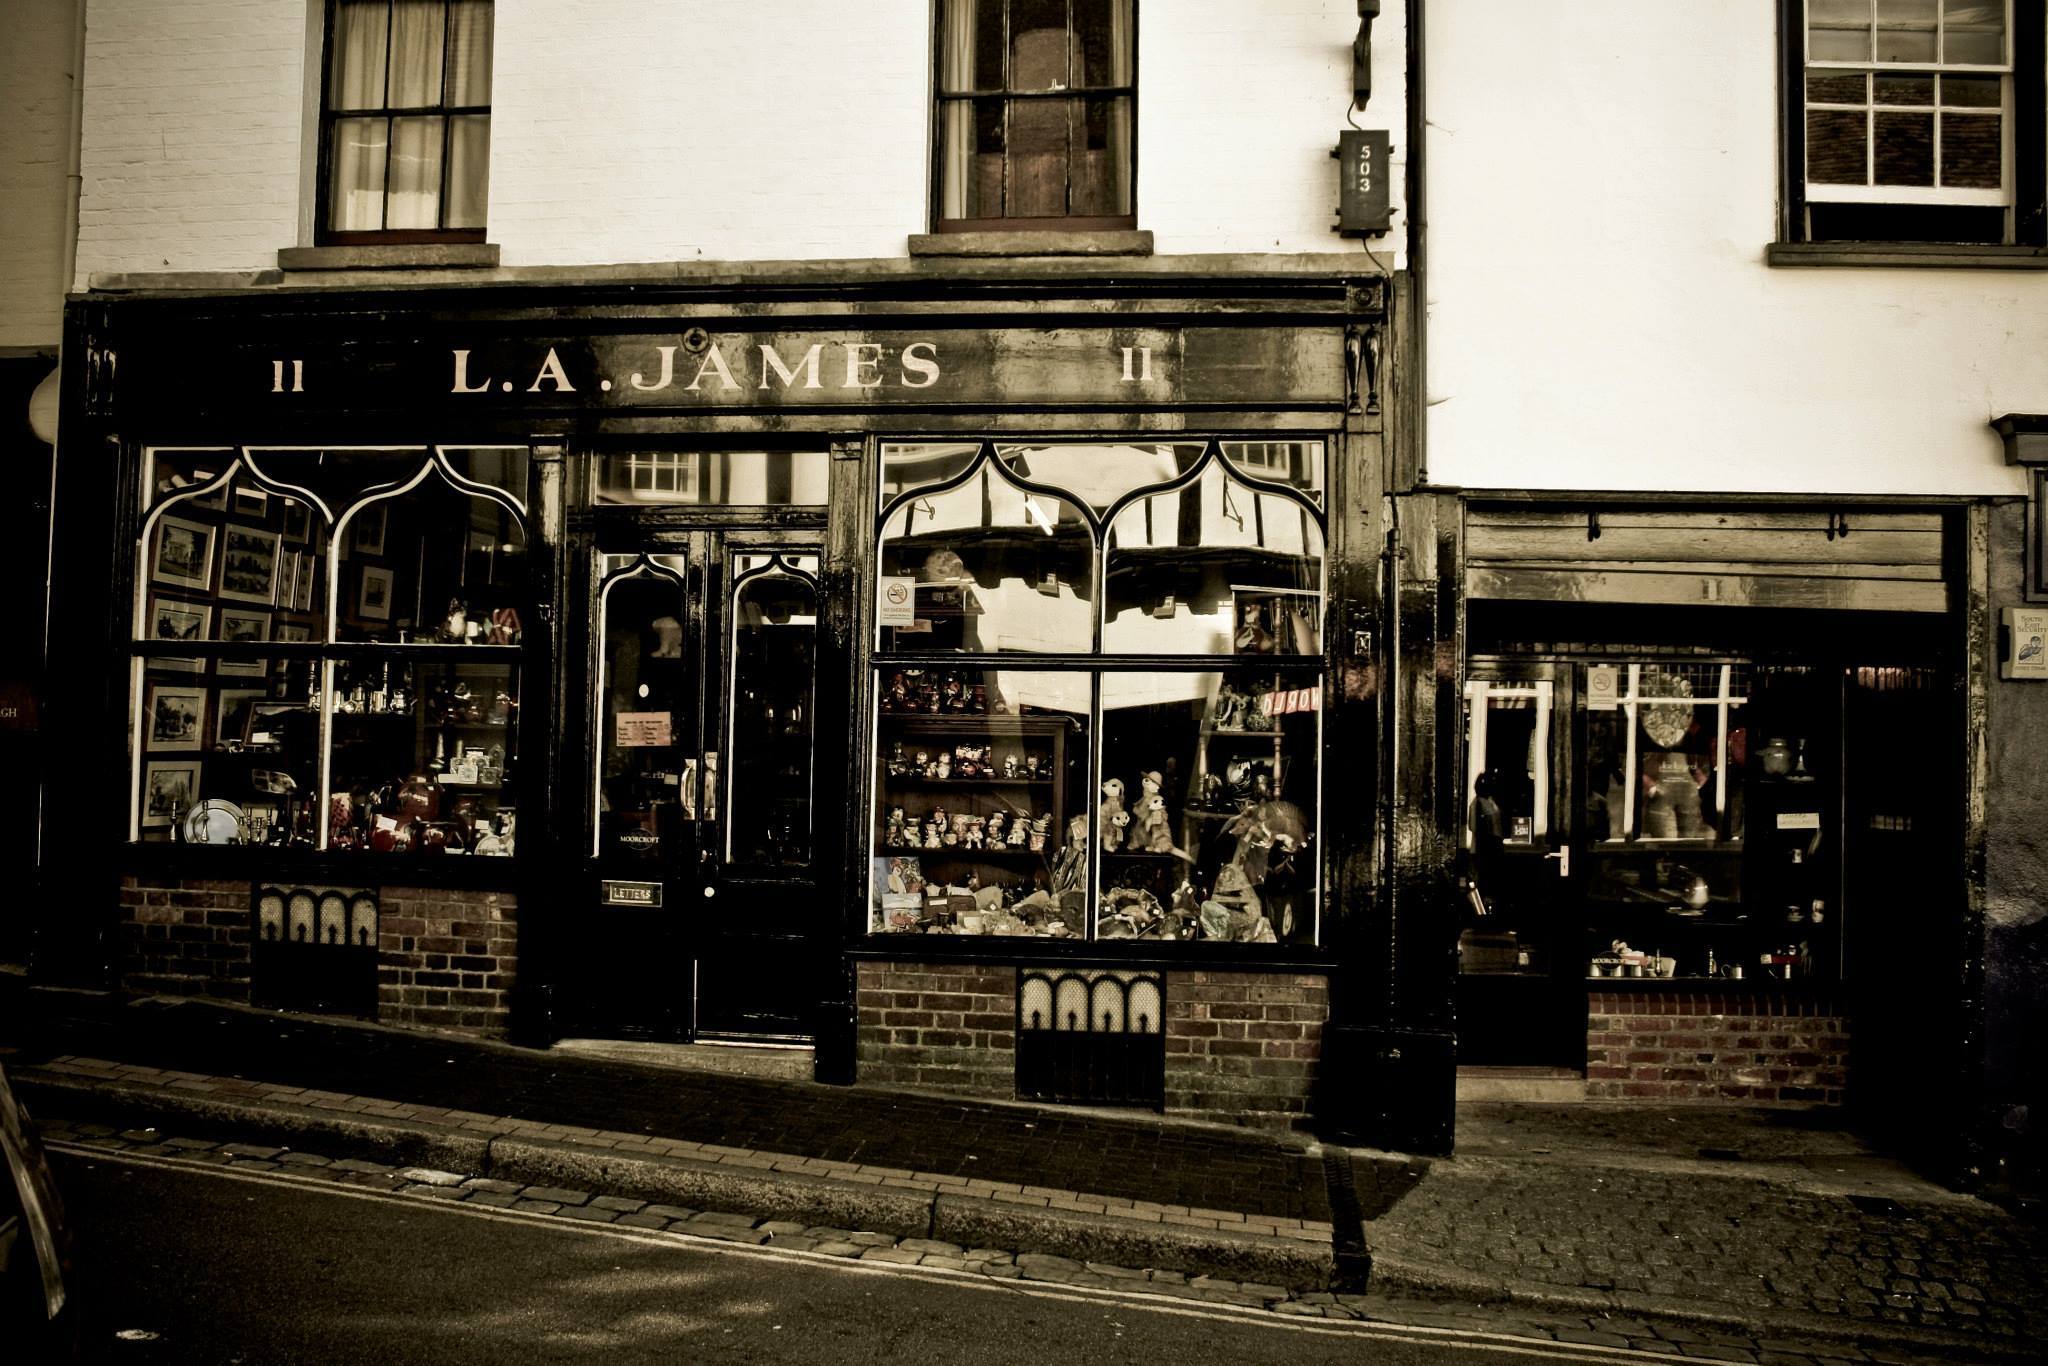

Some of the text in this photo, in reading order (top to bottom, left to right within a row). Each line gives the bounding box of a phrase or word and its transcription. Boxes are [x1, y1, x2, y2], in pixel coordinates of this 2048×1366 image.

[1359, 145, 1371, 193] 503
[271, 360, 304, 392] 11
[631, 342, 941, 391] JAMES
[1120, 347, 1155, 382] 11
[0, 707, 17, 718] GH
[620, 835, 660, 844] MOORCROFT
[613, 887, 651, 900] LETTERS
